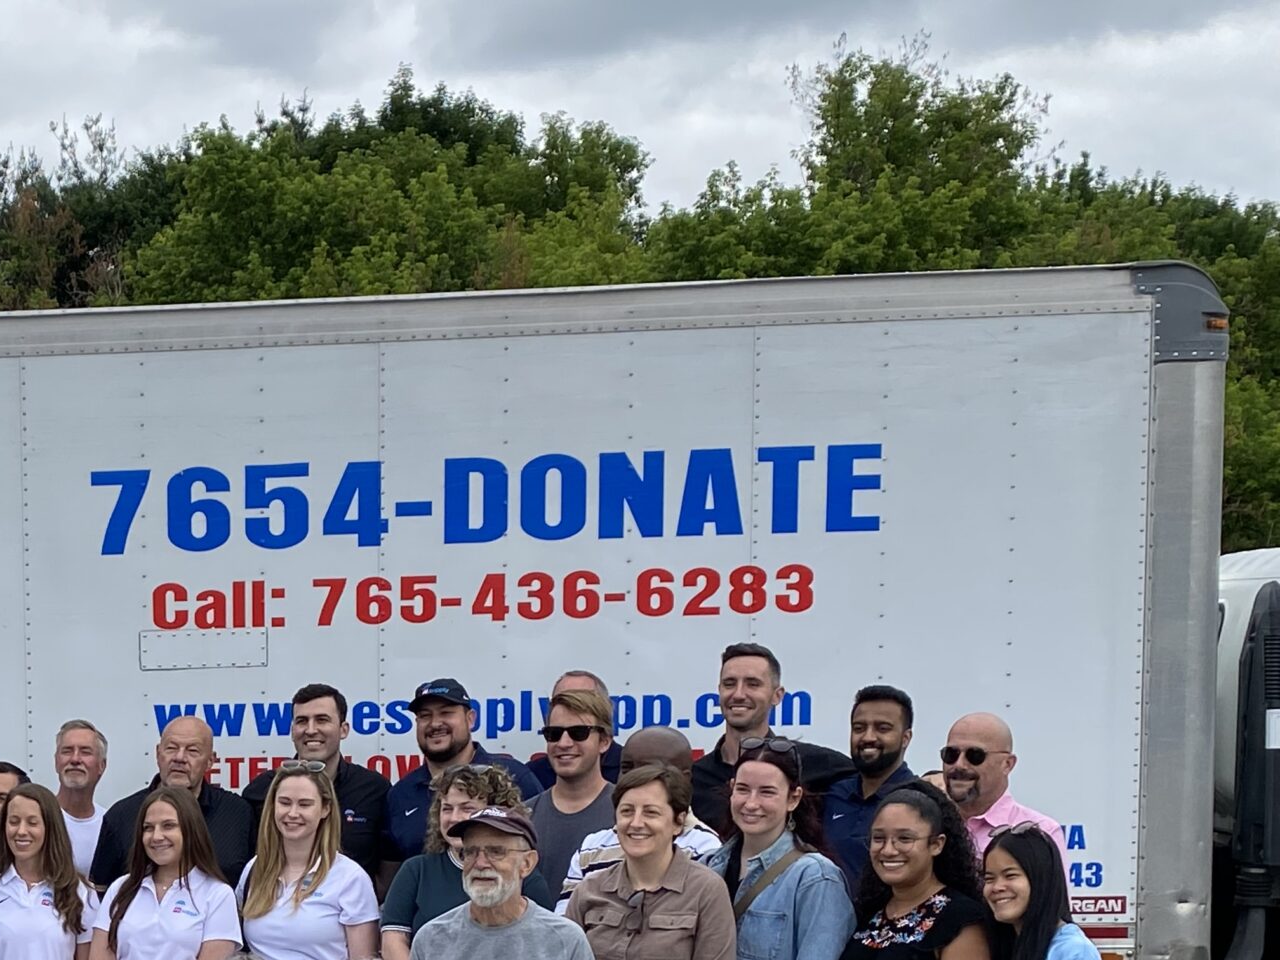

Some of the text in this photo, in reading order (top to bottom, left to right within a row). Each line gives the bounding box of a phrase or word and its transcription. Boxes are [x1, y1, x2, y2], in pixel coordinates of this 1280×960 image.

[90, 443, 882, 555] 7654-DONATE
[151, 564, 814, 629] Call: 765-436-6283
[1070, 899, 1122, 912] RGAN
